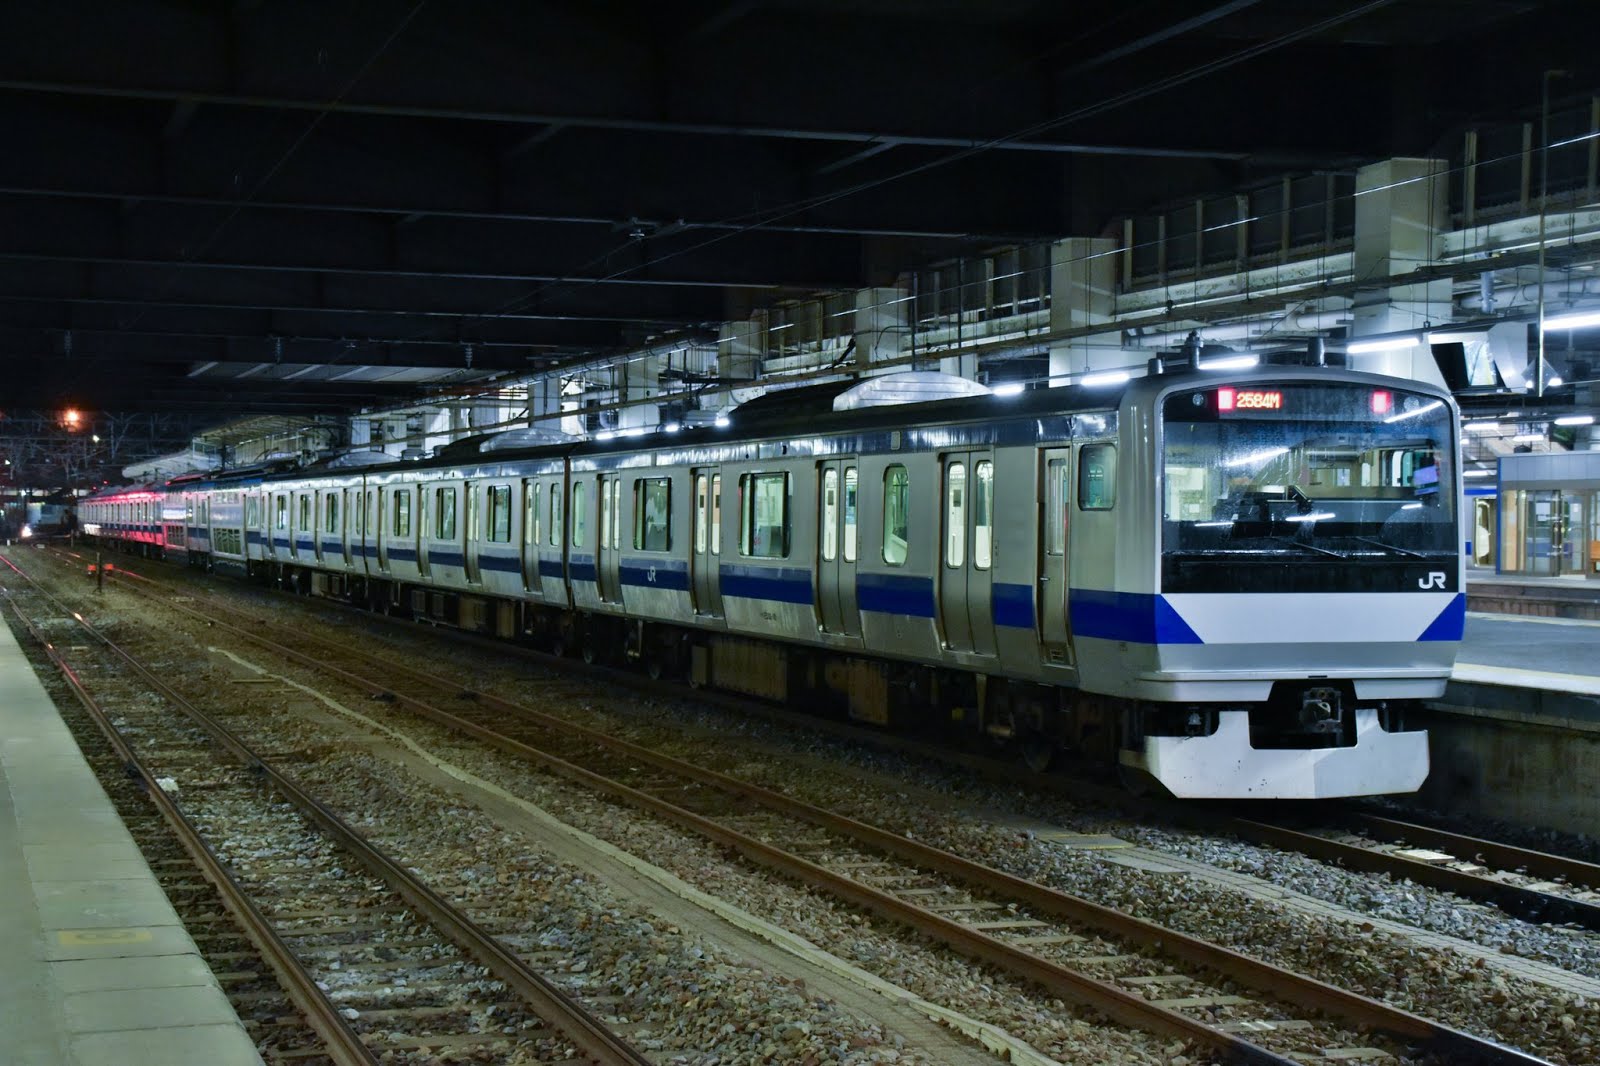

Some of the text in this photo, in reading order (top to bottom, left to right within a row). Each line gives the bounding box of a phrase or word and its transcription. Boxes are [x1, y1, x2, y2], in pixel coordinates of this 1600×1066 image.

[1237, 392, 1280, 408] 2584M
[647, 566, 656, 582] JR
[1418, 571, 1446, 589] JR
